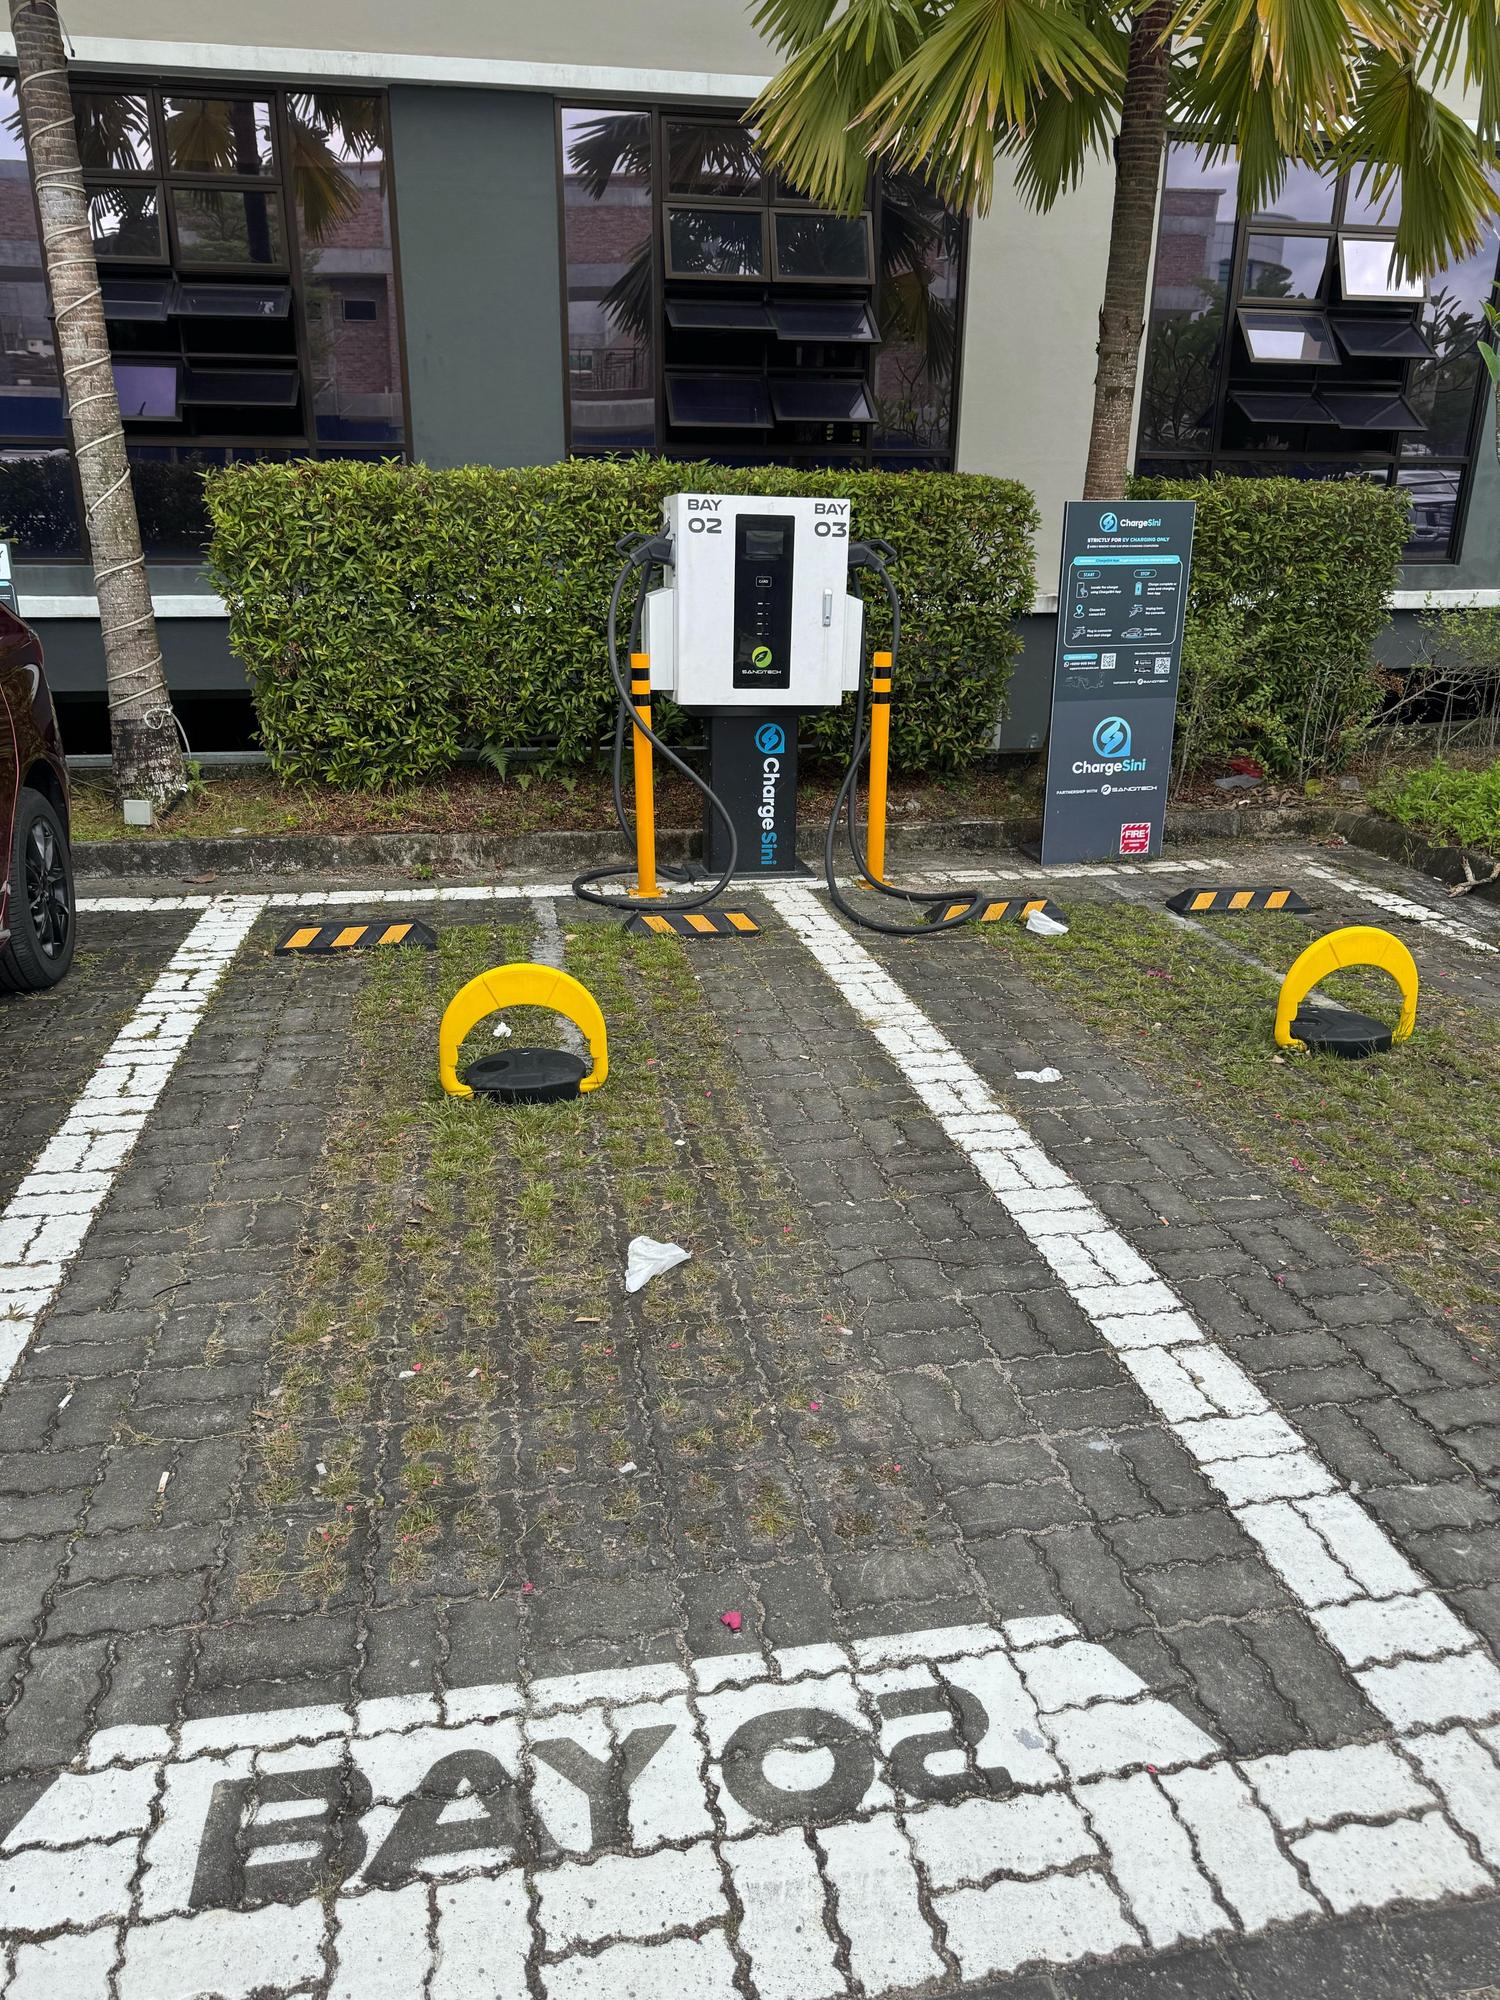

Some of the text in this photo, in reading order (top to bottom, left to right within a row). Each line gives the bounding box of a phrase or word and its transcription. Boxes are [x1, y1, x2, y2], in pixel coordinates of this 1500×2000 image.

[688, 499, 722, 511] BAY
[814, 503, 848, 515] BAY
[688, 517, 722, 534] 02
[814, 521, 847, 538] 03
[1120, 518, 1161, 528] ChargeSini
[1072, 758, 1147, 776] ChargeSini
[757, 757, 781, 865] ChargeSini
[1125, 829, 1146, 838] FIRE
[191, 1685, 1010, 1907] BAY 02
